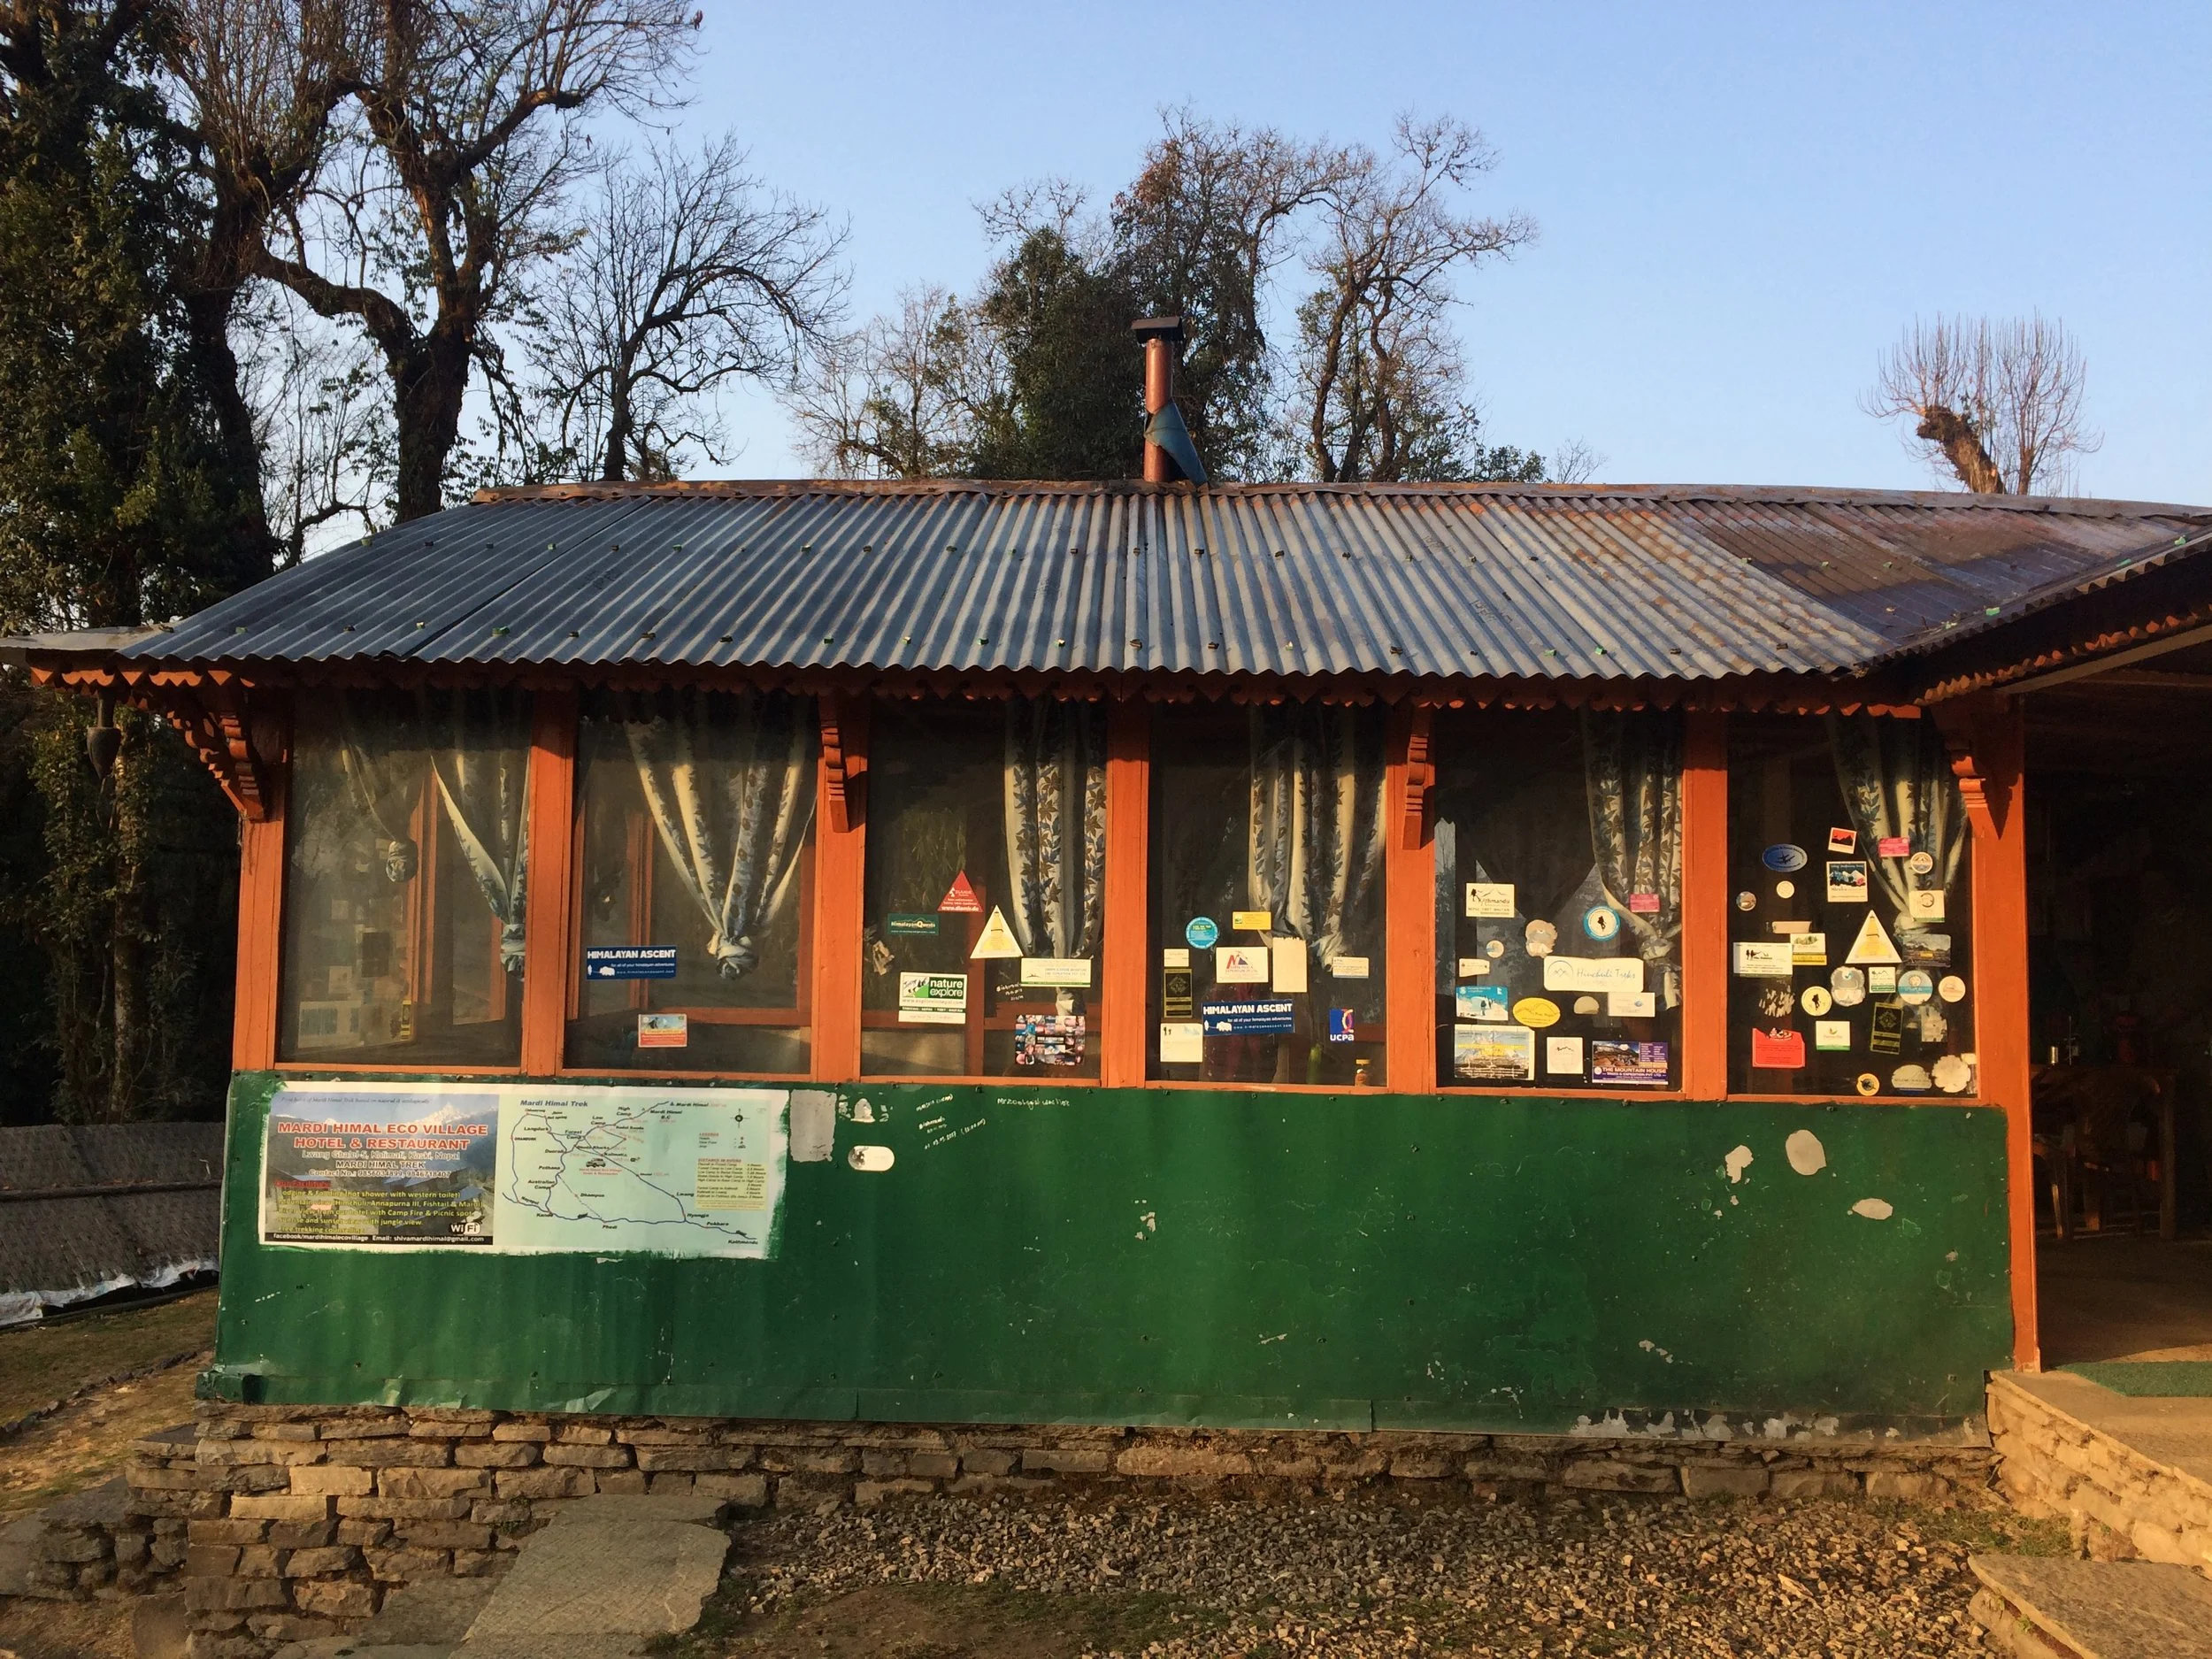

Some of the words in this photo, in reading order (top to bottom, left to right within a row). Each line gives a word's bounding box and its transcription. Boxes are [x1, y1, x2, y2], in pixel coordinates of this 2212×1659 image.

[587, 949, 639, 959] HIMALAYAN
[640, 949, 677, 958] ASCENT
[930, 979, 964, 988] nature
[929, 987, 964, 997] explore
[1202, 1005, 1255, 1015] HIMALAYAN
[1256, 1003, 1293, 1013] ASCENT
[278, 1122, 328, 1133] MARDI
[332, 1122, 381, 1133] HIMAL
[387, 1124, 419, 1134] ECO
[423, 1124, 488, 1135] VILLAGE
[294, 1137, 346, 1148] HOTEL
[349, 1138, 362, 1148] &
[366, 1138, 470, 1150] RESTAURANT
[309, 1169, 340, 1178] Contact
[388, 1210, 409, 1218] Camp
[380, 1218, 404, 1227] jungle
